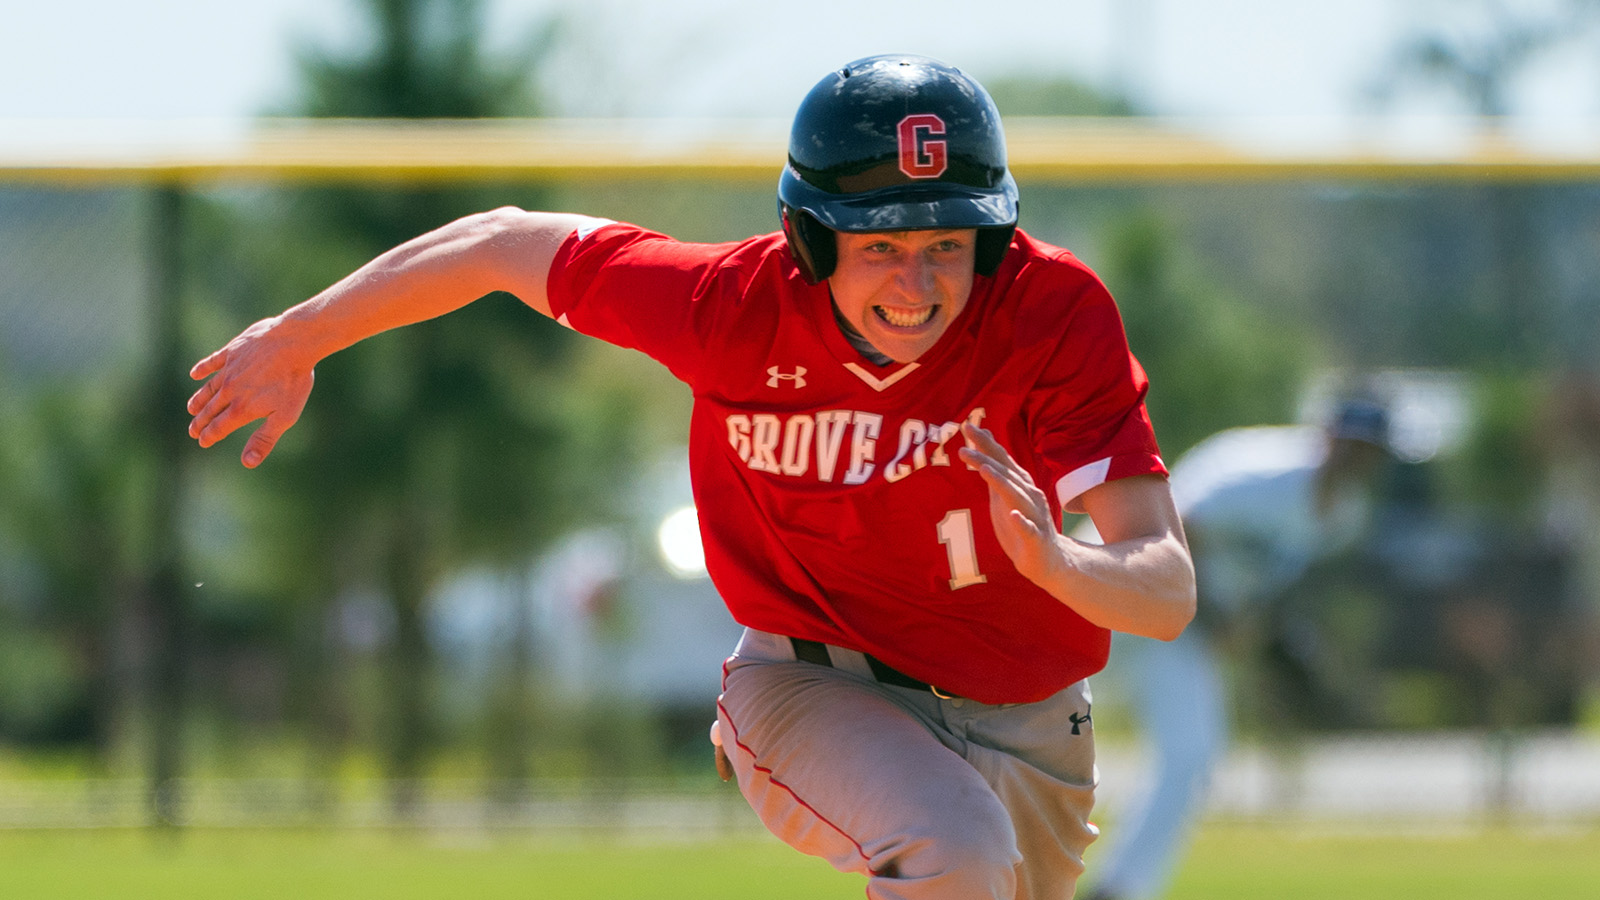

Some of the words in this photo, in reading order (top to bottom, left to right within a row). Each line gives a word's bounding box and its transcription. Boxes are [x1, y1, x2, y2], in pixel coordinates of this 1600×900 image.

[897, 113, 947, 179] G
[725, 409, 883, 485] GROVE
[936, 508, 988, 591] 1
